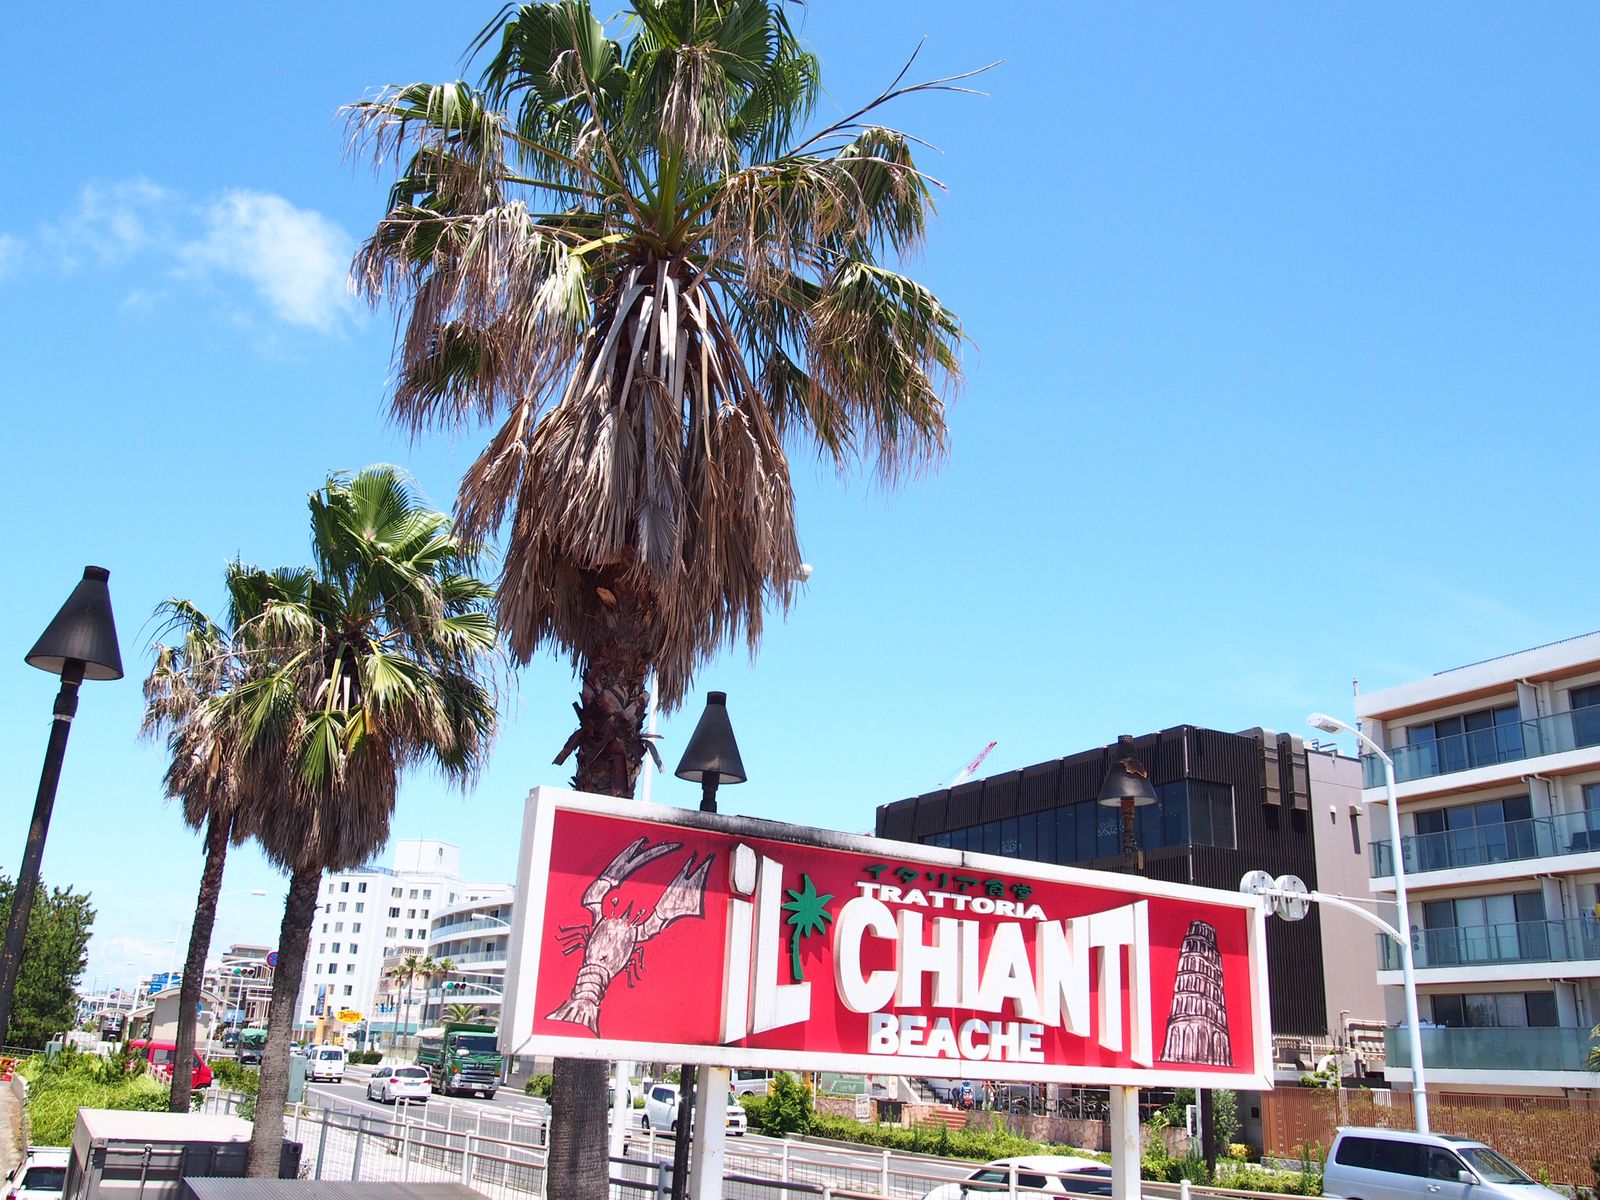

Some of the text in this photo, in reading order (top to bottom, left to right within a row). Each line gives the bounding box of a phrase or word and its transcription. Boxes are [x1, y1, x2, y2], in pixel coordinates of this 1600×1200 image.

[856, 881, 1048, 920] TRATTORIA
[865, 864, 1034, 900] イタリア食堂
[835, 898, 1153, 1067] CHIANTI
[868, 1013, 1045, 1063] BEACHE
